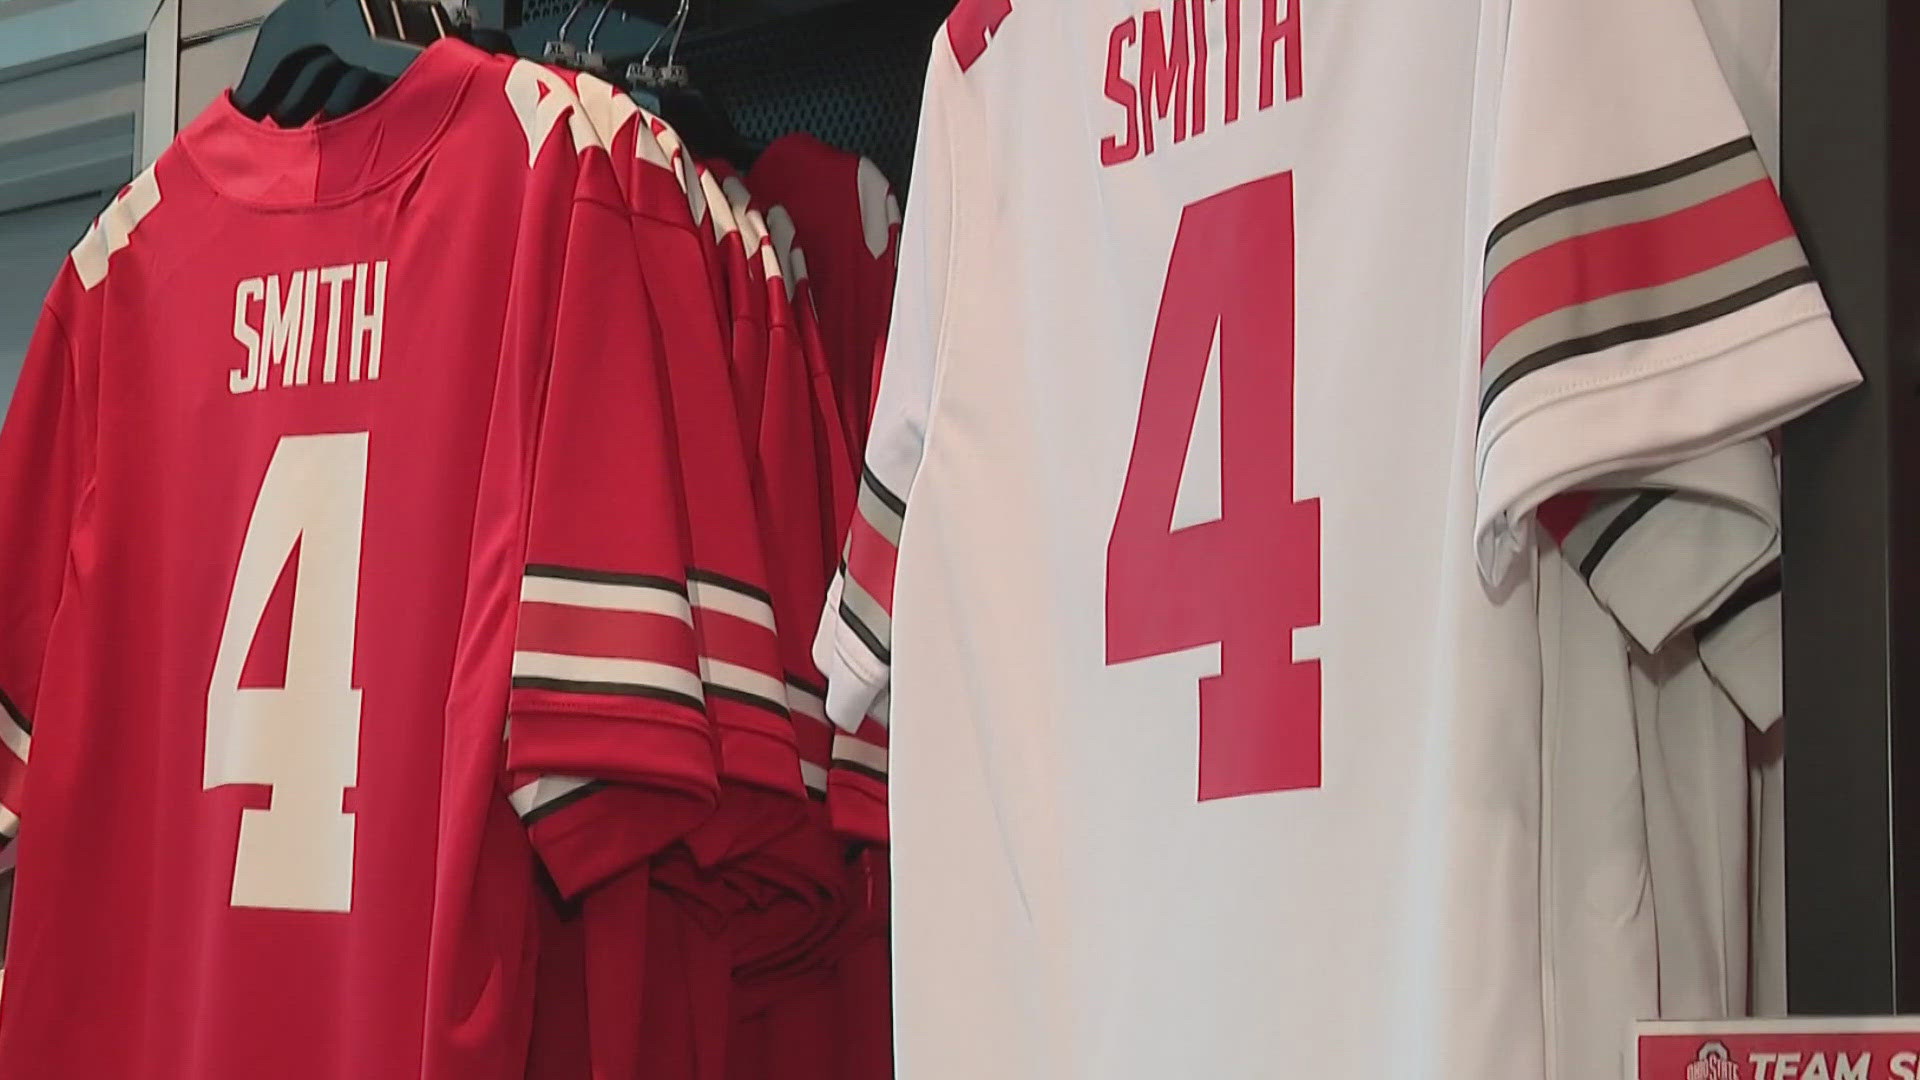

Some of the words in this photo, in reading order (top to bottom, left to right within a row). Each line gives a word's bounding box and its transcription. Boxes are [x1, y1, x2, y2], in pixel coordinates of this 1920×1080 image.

[1100, 0, 1303, 167] SMITH
[229, 260, 388, 394] SMITH
[1106, 171, 1323, 801] 4
[203, 431, 370, 913] 4
[1749, 1052, 1872, 1080] TEAM
[1889, 1051, 1920, 1080] S
